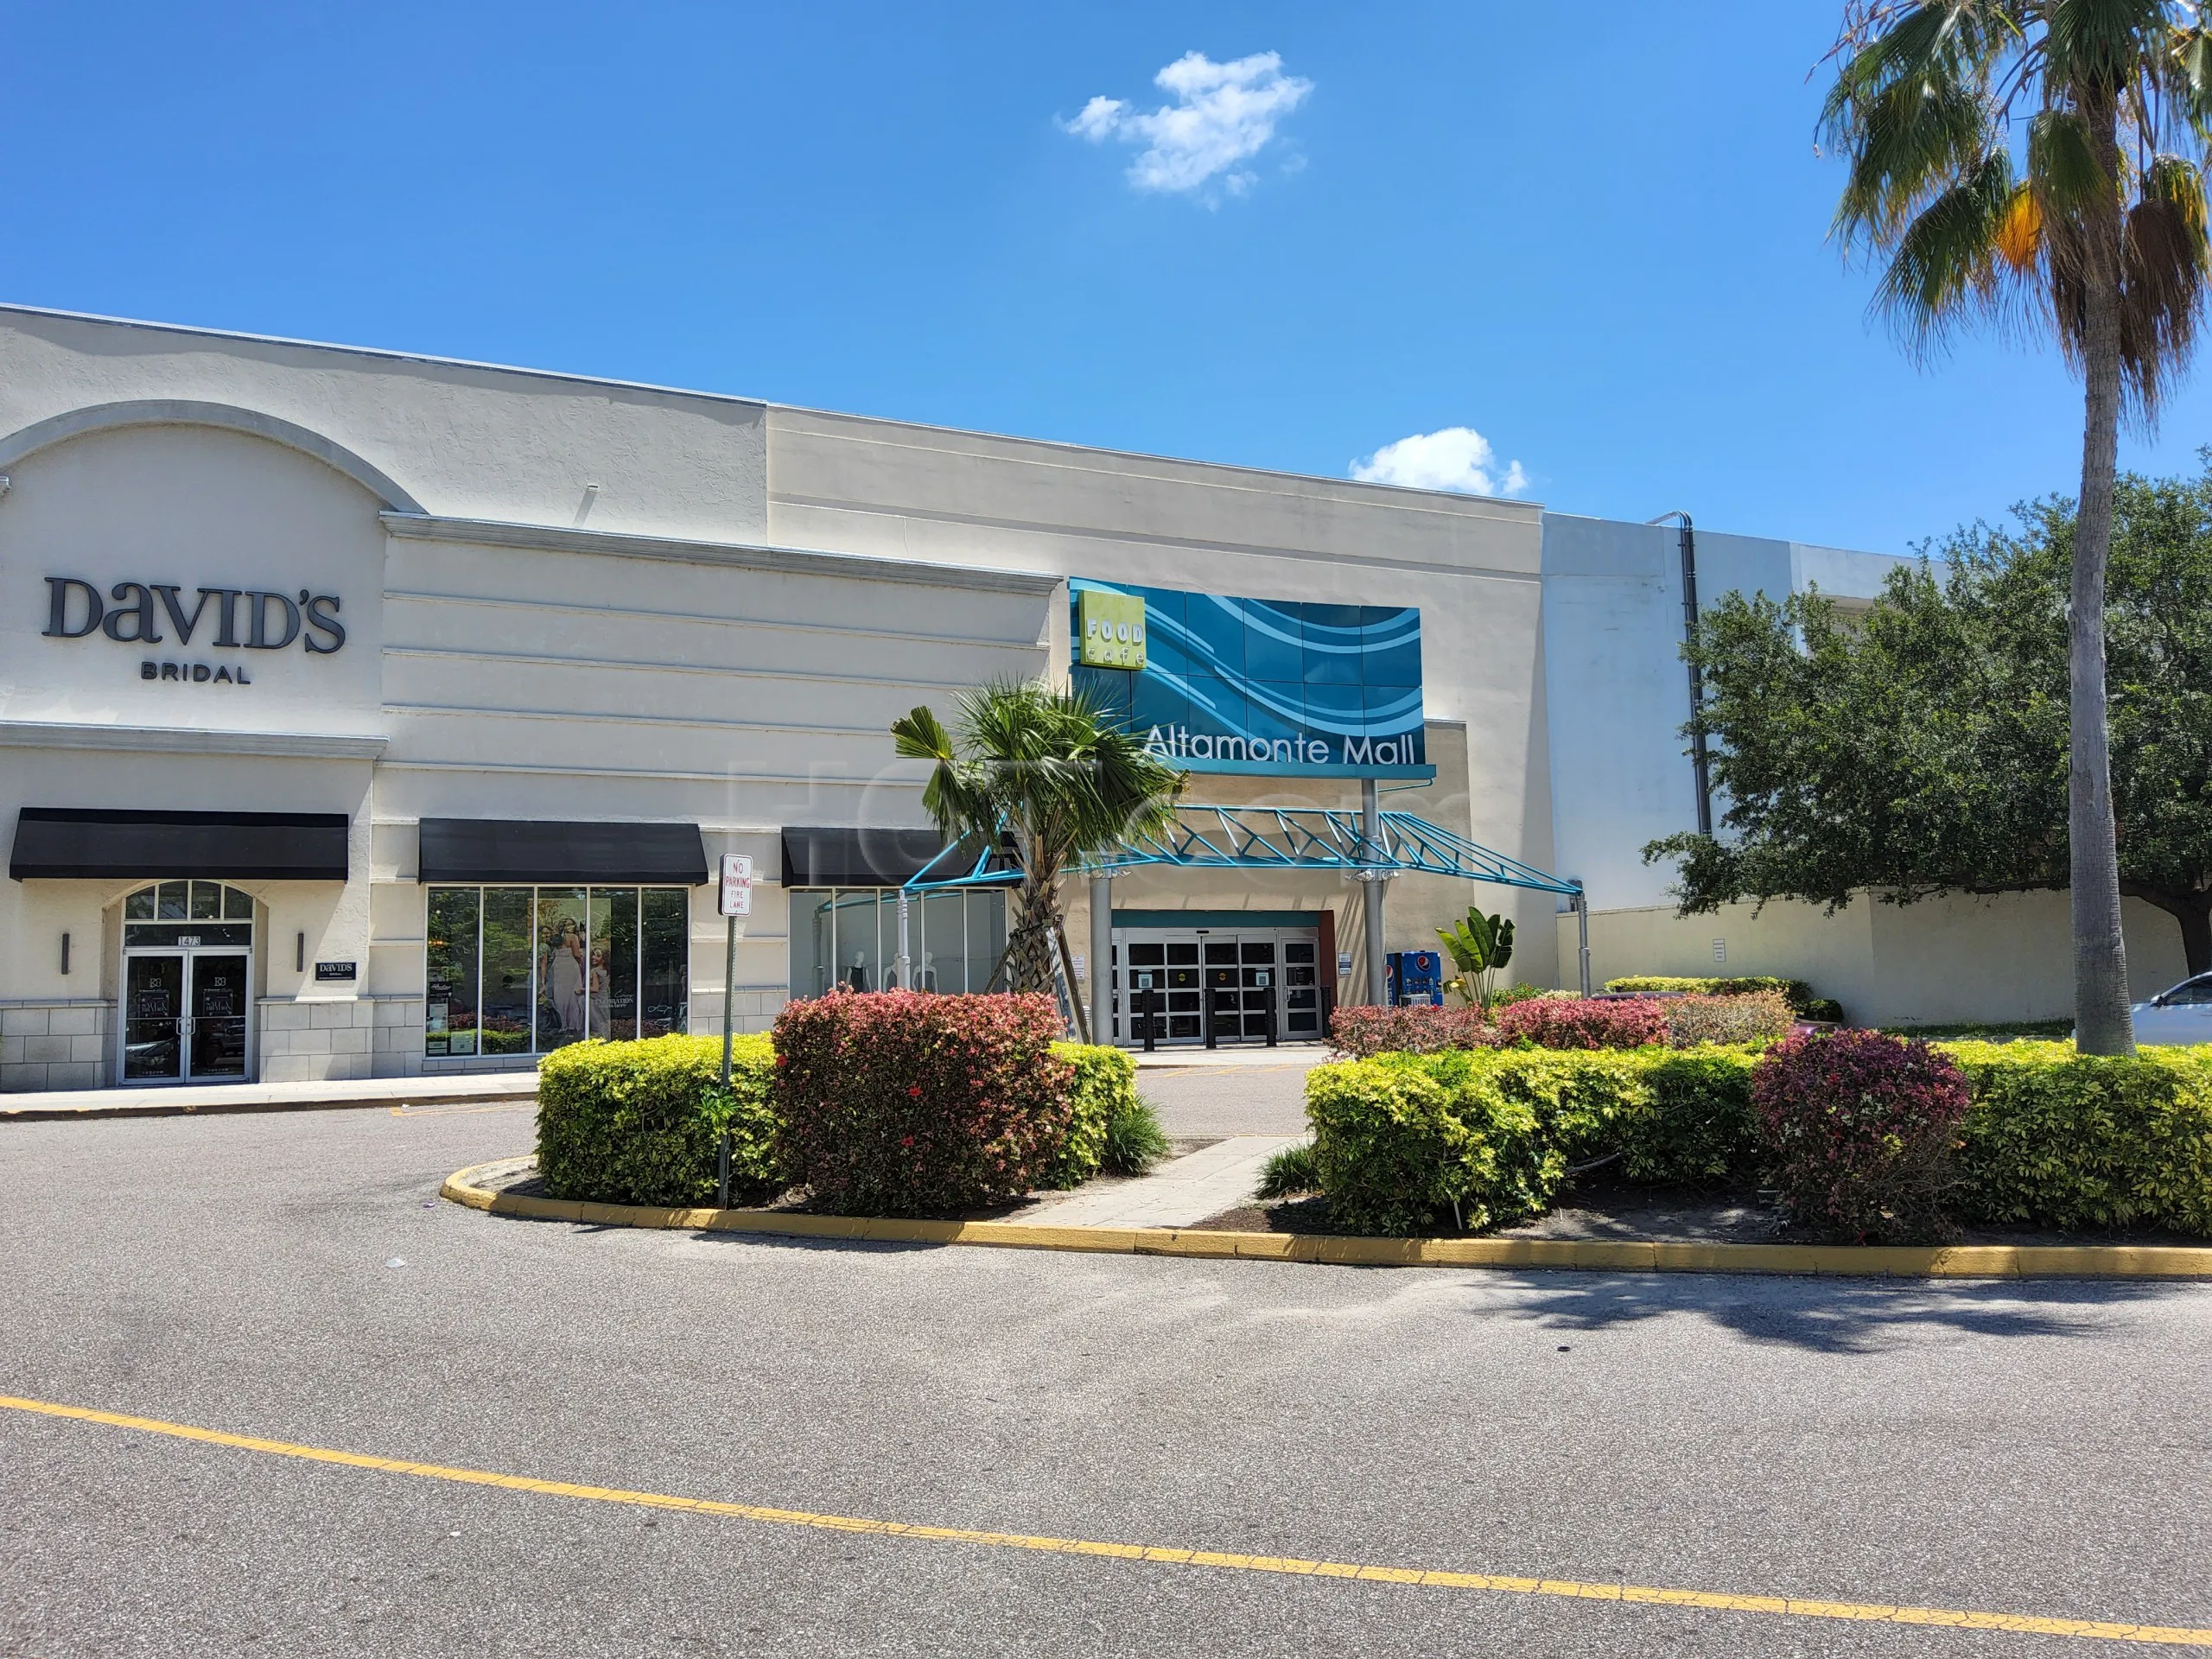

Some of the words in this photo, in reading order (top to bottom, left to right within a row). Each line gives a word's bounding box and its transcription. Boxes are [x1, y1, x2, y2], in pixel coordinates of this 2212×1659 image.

[1087, 619, 1143, 644] FOOD
[1087, 647, 1145, 665] cafe
[140, 661, 251, 684] BRIDAL
[1143, 724, 1329, 764] Altamonte
[1344, 734, 1414, 765] Mall
[733, 862, 744, 874] NO
[726, 876, 750, 888] PARKING
[731, 890, 744, 899] FIRE
[179, 937, 200, 946] 1473
